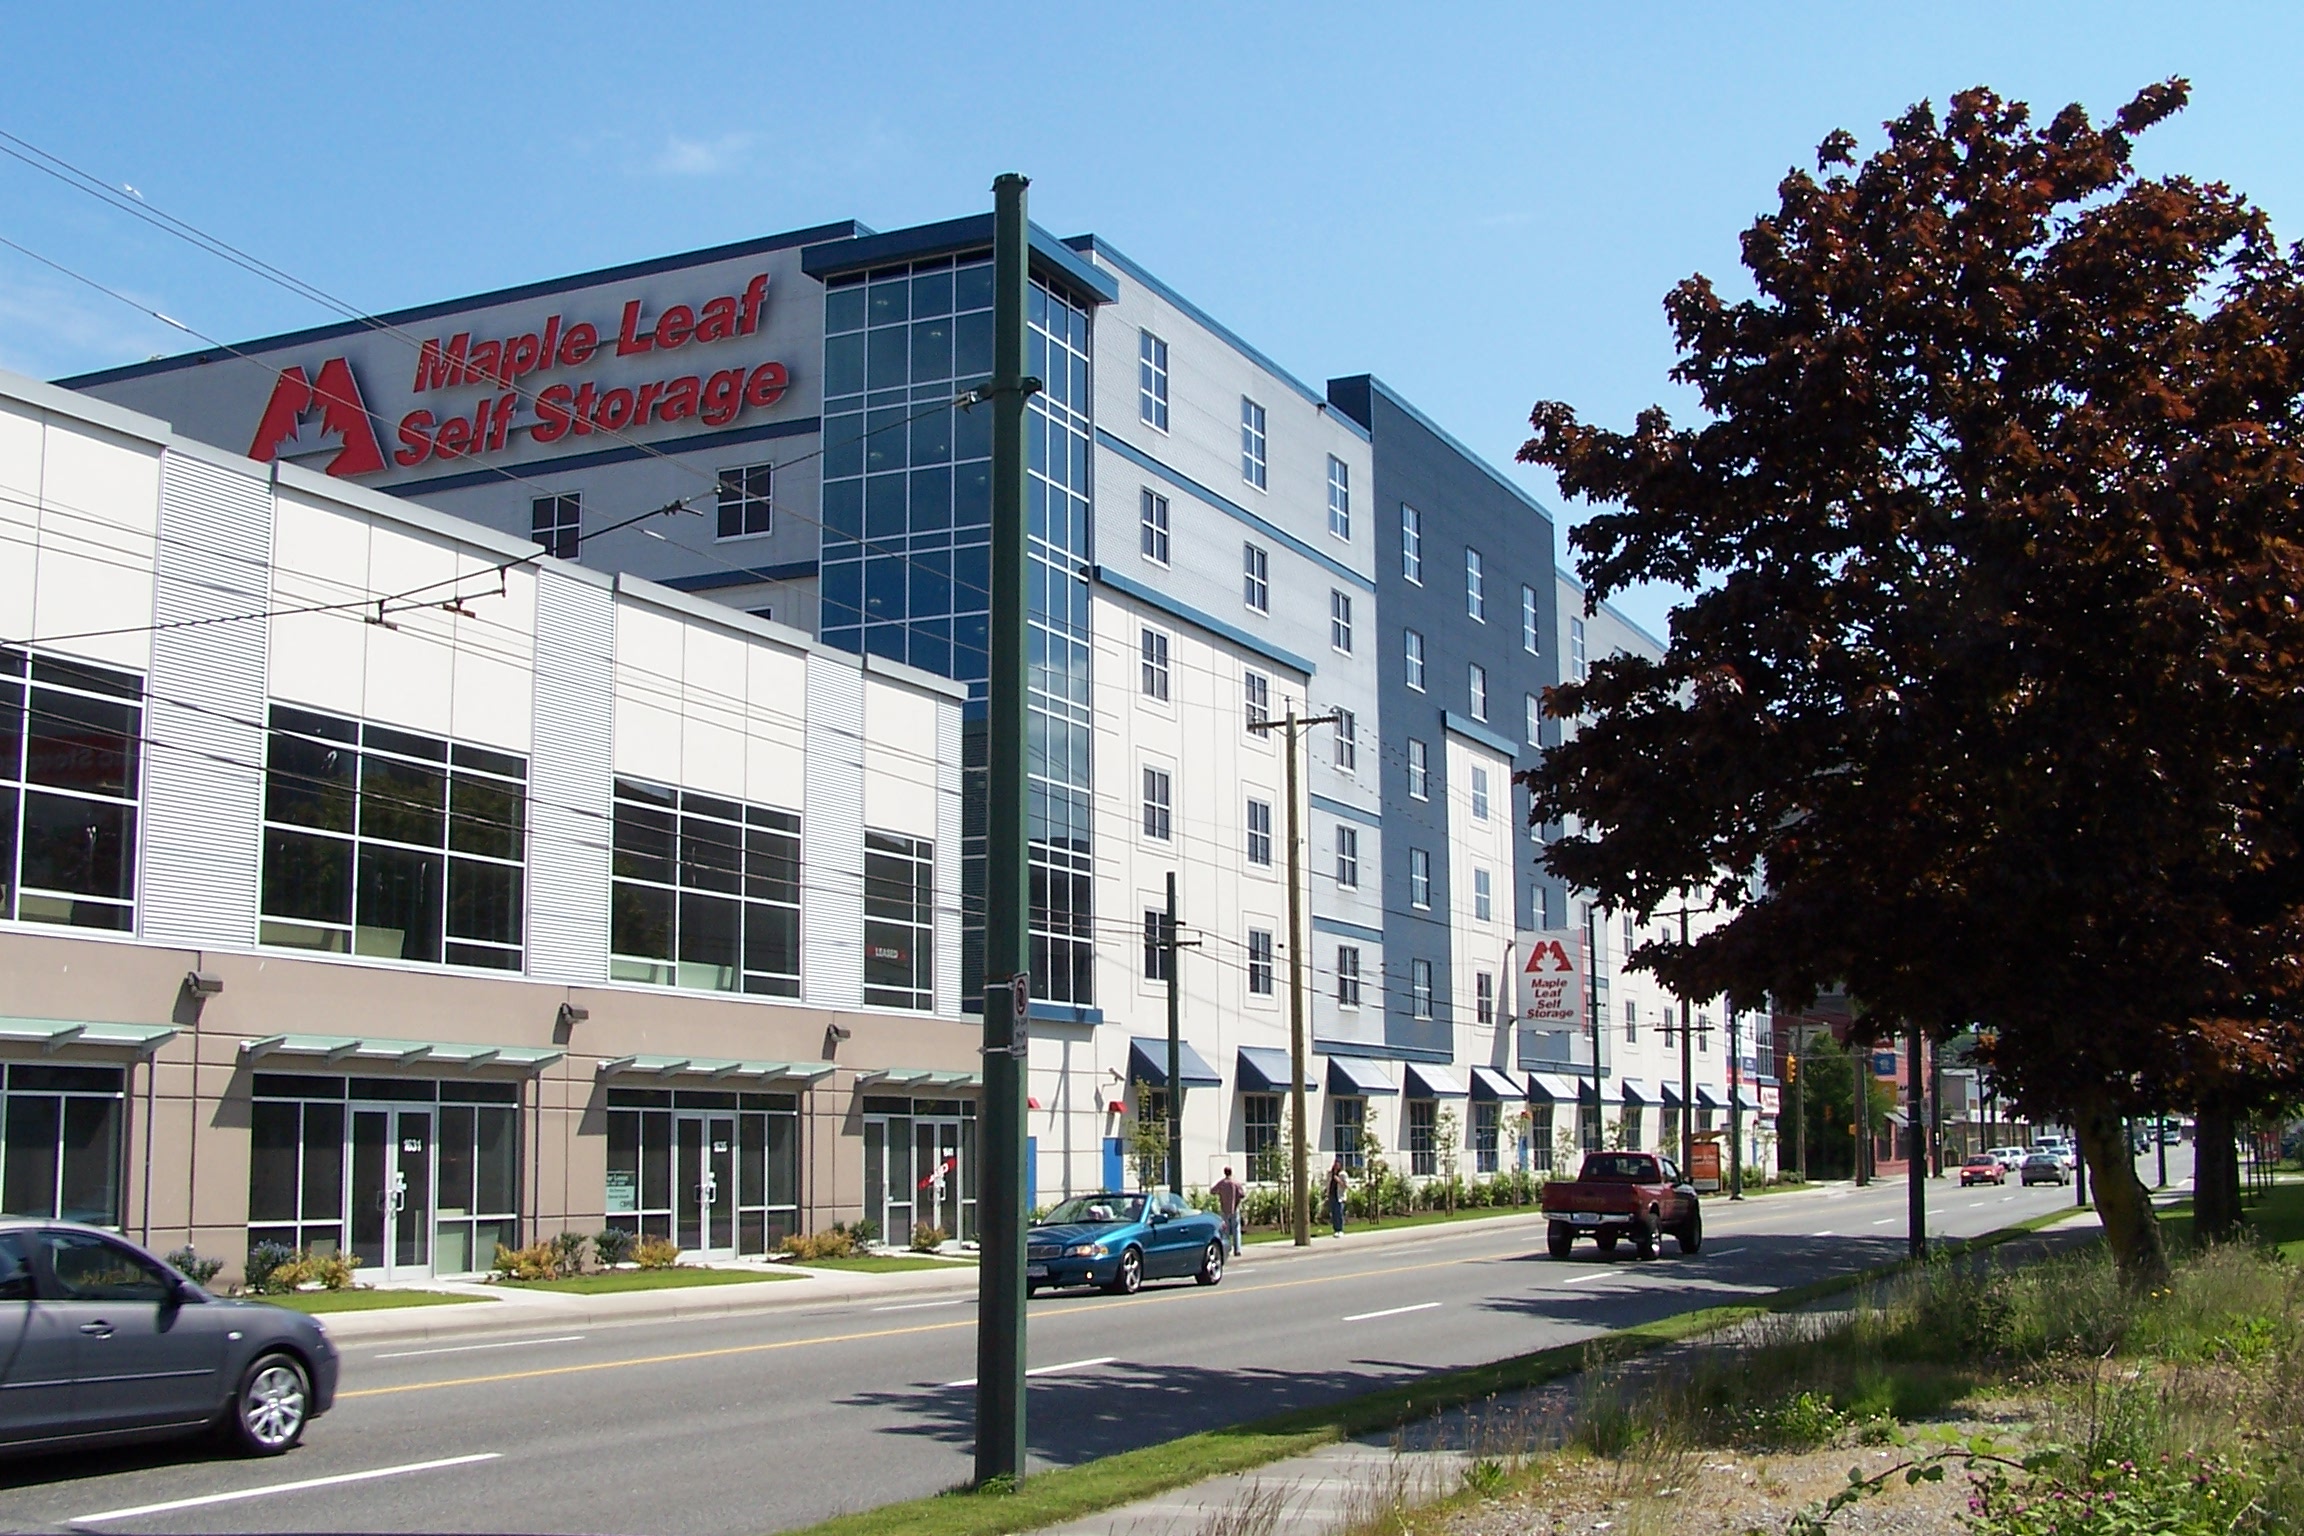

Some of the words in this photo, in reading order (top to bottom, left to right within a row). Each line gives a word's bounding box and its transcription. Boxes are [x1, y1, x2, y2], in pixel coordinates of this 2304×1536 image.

[413, 314, 598, 393] Maple
[615, 273, 770, 358] Leaf
[393, 392, 517, 468] Self
[529, 359, 790, 444] Storage
[875, 946, 899, 959] LEASED
[1531, 978, 1568, 989] Maple
[1535, 988, 1562, 998] Leaf
[1537, 999, 1561, 1009] Self
[1527, 1008, 1574, 1020] Storage
